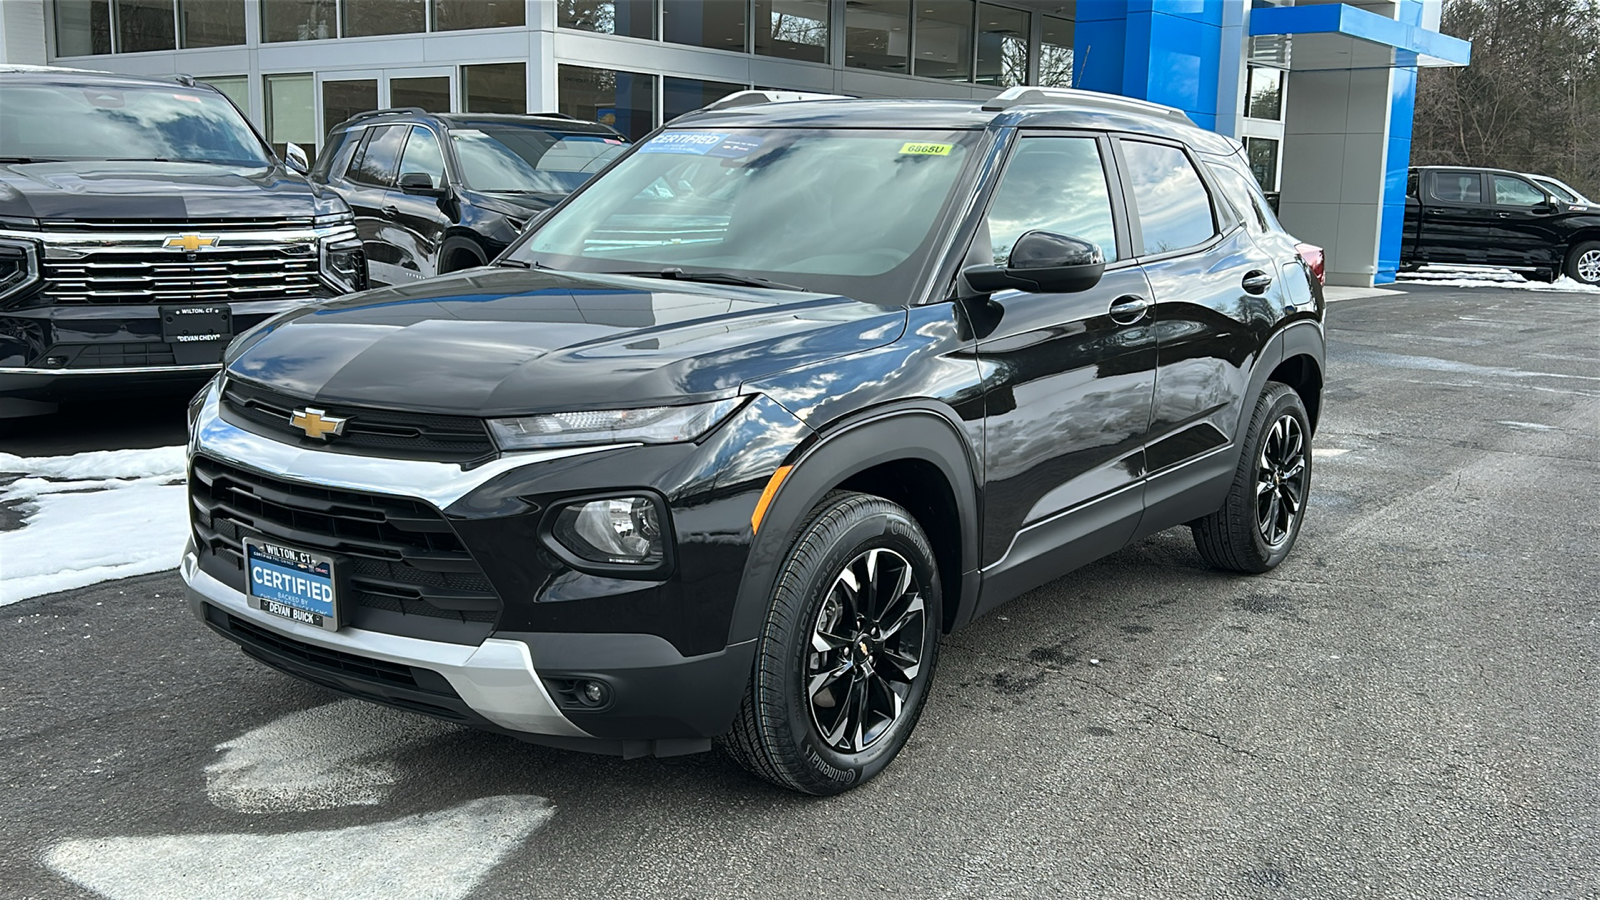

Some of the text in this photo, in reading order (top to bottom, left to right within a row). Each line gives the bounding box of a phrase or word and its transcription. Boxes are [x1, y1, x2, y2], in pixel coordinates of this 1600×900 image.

[651, 134, 720, 144] CERTIFIED
[907, 145, 945, 153] 6865U
[265, 544, 310, 564] WILTON, CT
[252, 566, 333, 603] CERTIFIED
[277, 591, 300, 603] BACKED
[301, 598, 309, 606] BY
[269, 602, 290, 618] DEVAN
[292, 609, 314, 625] BUICK
